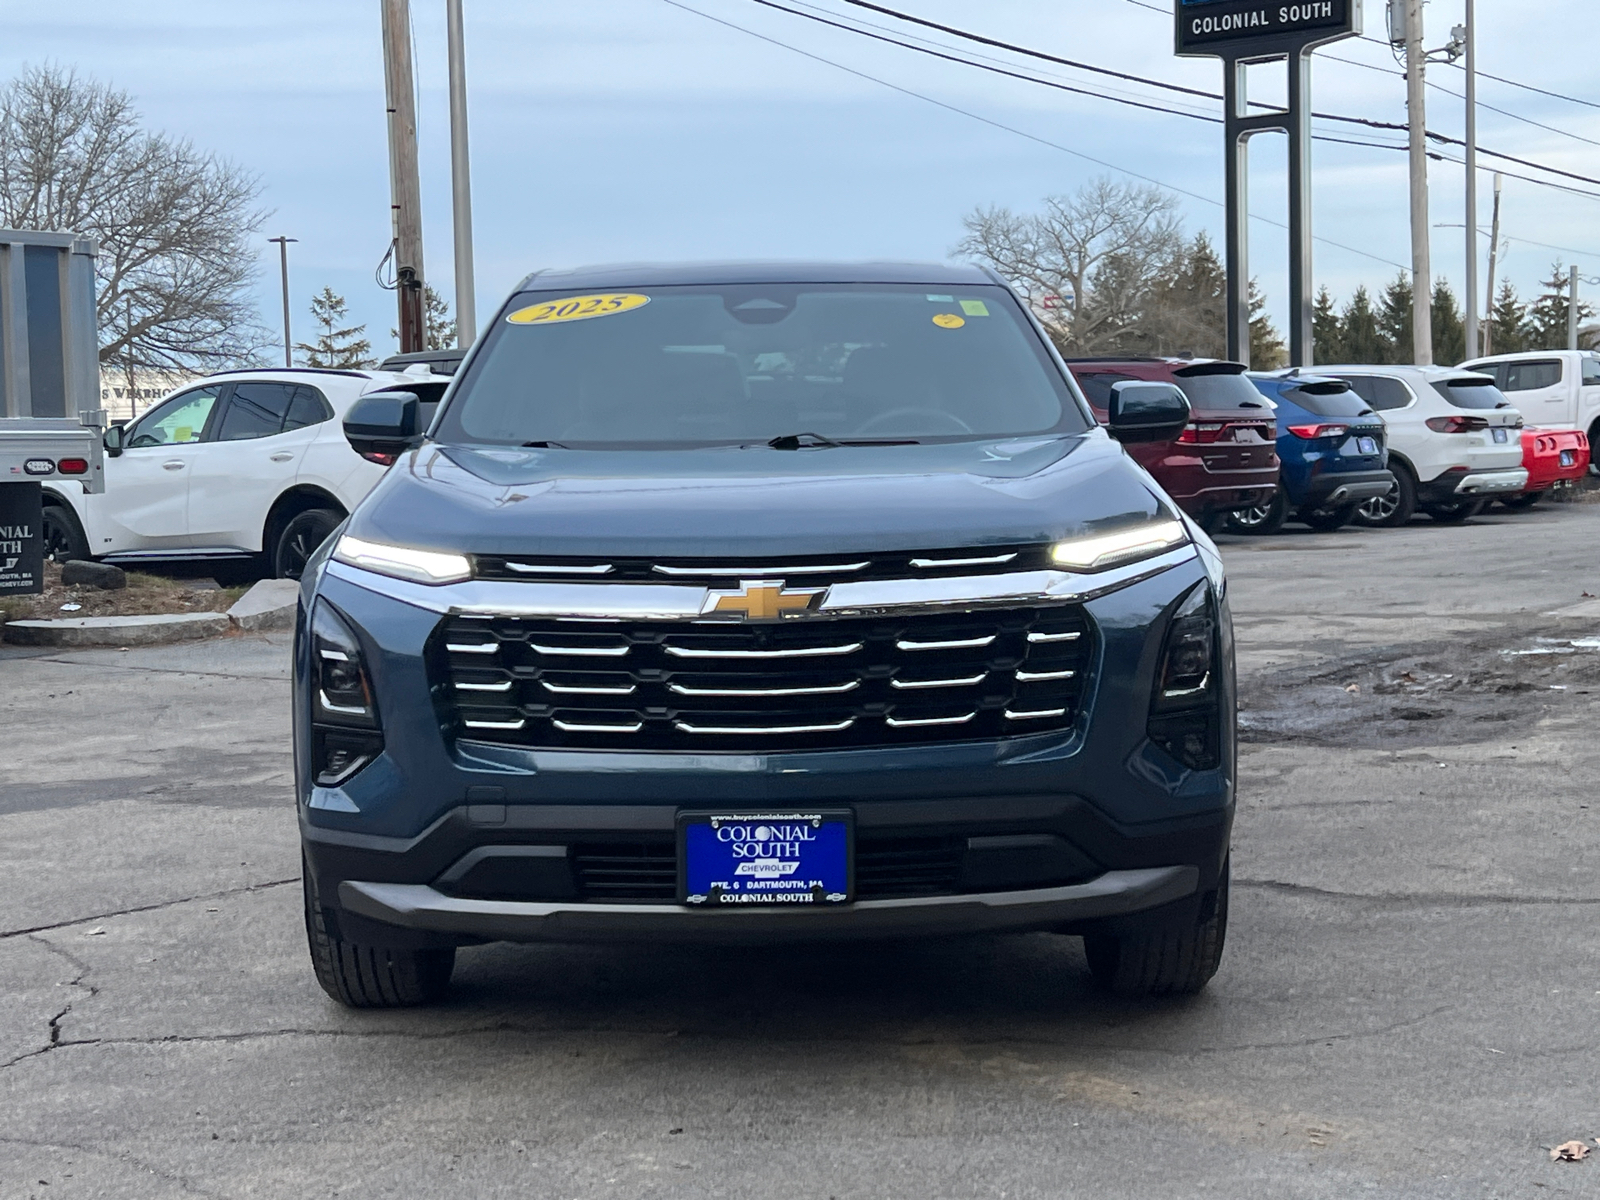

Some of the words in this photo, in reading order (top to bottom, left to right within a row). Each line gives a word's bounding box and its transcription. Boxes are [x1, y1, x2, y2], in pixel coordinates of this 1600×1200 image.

[1192, 10, 1269, 35] COLONIAL
[1279, 1, 1332, 23] SOUTH
[530, 295, 628, 322] 2025
[716, 825, 816, 842] COLONIAL
[732, 842, 800, 858] SOUTH
[741, 864, 793, 872] CHEVROLET
[733, 881, 740, 889] 6
[746, 880, 807, 890] DARTMOUTH,
[720, 893, 775, 903] COLONIAL
[776, 893, 813, 902] SOUTH
